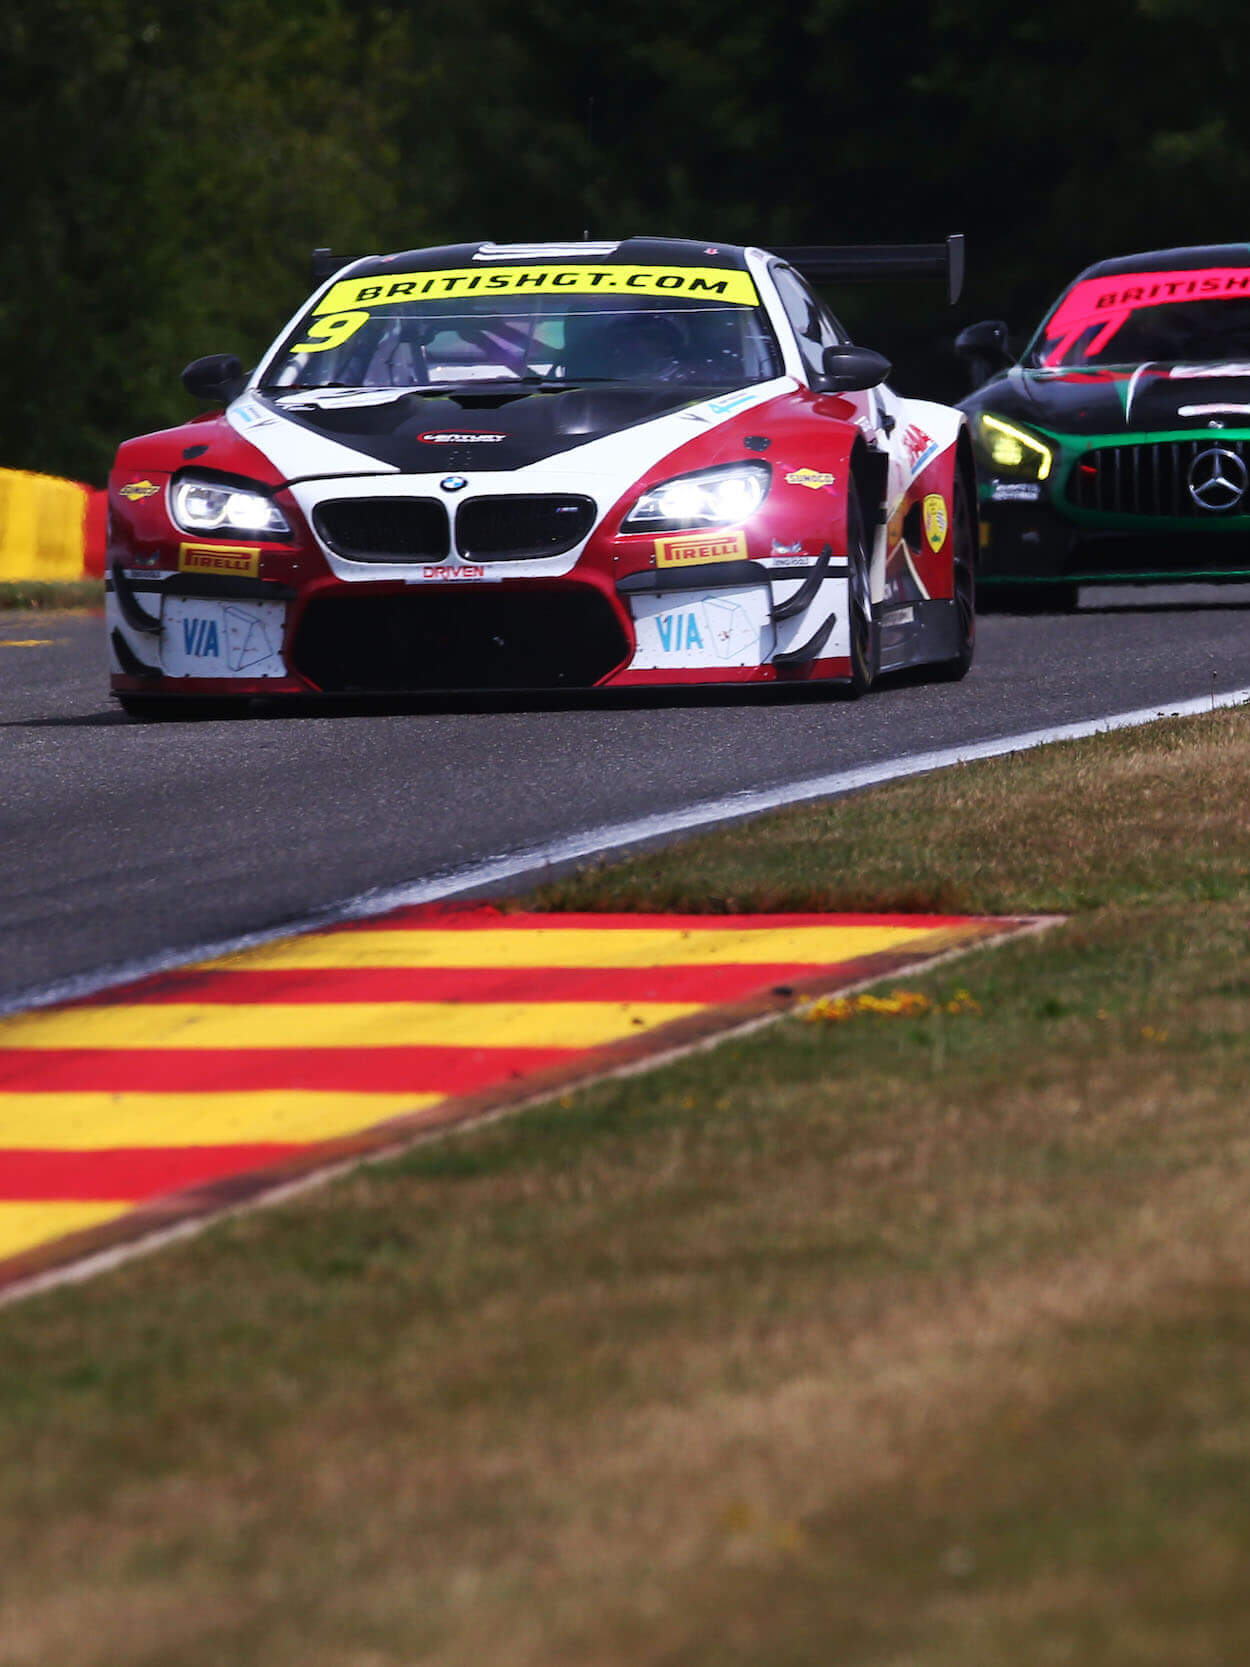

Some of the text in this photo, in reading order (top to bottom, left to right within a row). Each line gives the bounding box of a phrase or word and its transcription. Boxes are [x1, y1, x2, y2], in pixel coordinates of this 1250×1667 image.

[355, 272, 729, 302] BRITISHGT.COM
[289, 311, 371, 353] 9
[184, 548, 253, 571] PIRELLI
[663, 536, 739, 561] PIRELLI
[423, 566, 484, 580] DRIVEN
[183, 618, 219, 657] VIA
[655, 612, 704, 652] VIA
